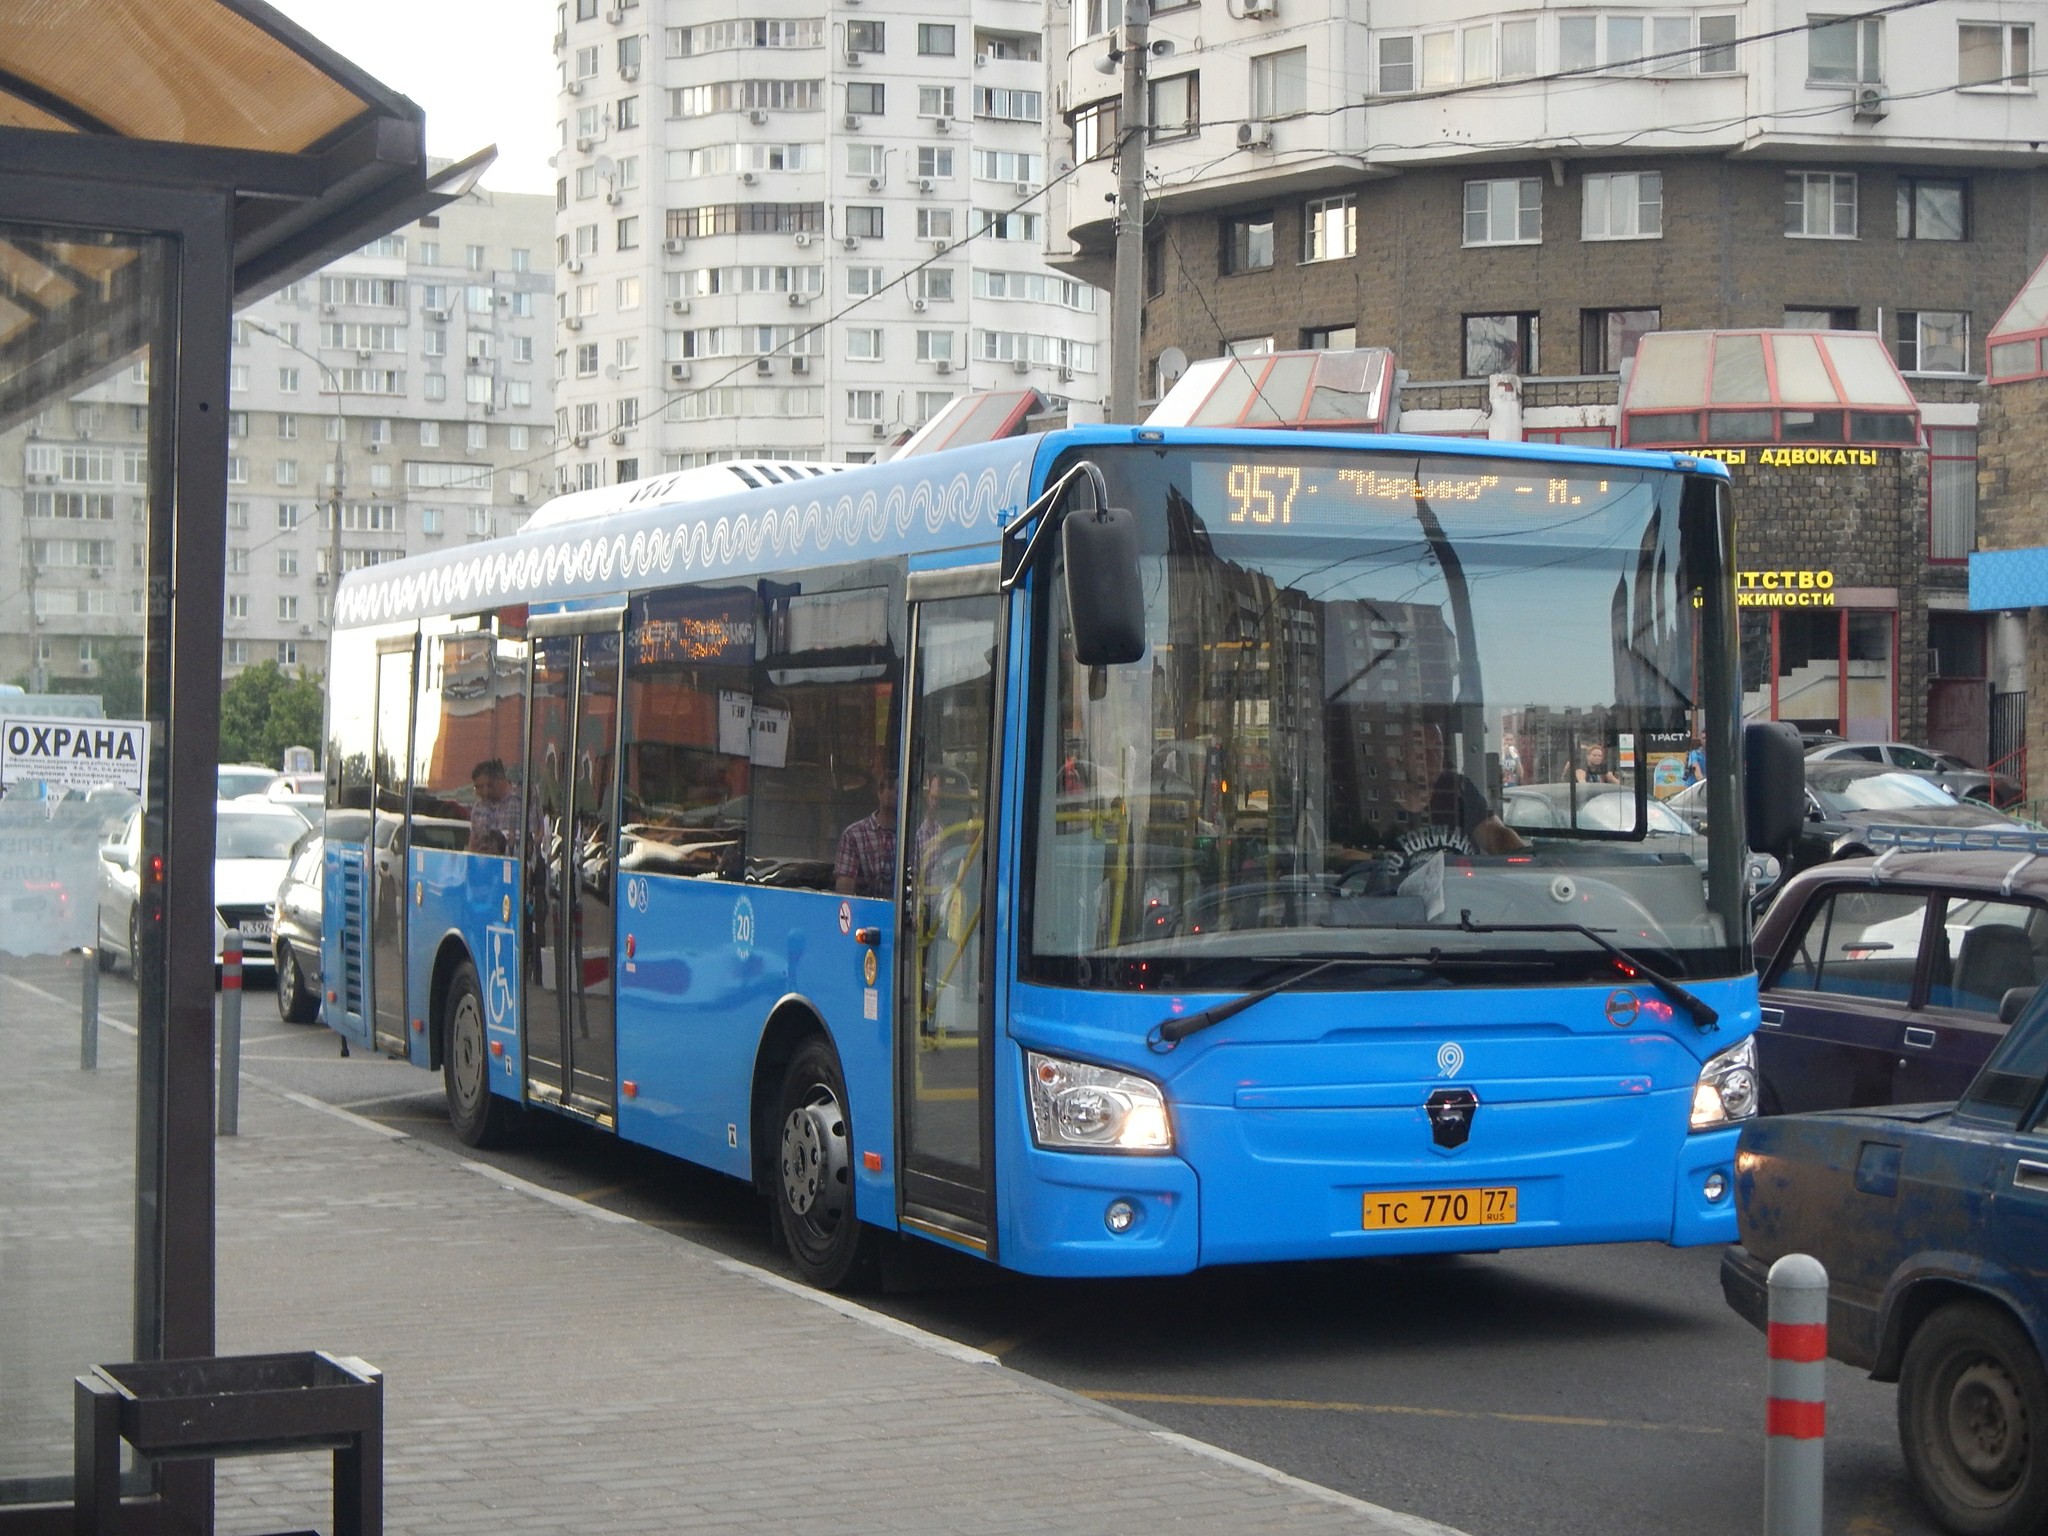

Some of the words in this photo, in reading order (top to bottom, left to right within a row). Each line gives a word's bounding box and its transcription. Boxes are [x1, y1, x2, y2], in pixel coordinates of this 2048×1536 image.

[1760, 449, 1877, 467] АДВОКАТЫ
[1228, 464, 1300, 523] 957
[8, 725, 137, 761] ОХРАНА
[737, 914, 750, 942] 20
[1421, 1194, 1469, 1223] 770
[1484, 1191, 1508, 1212] 77
[1487, 1213, 1505, 1221] RUS
